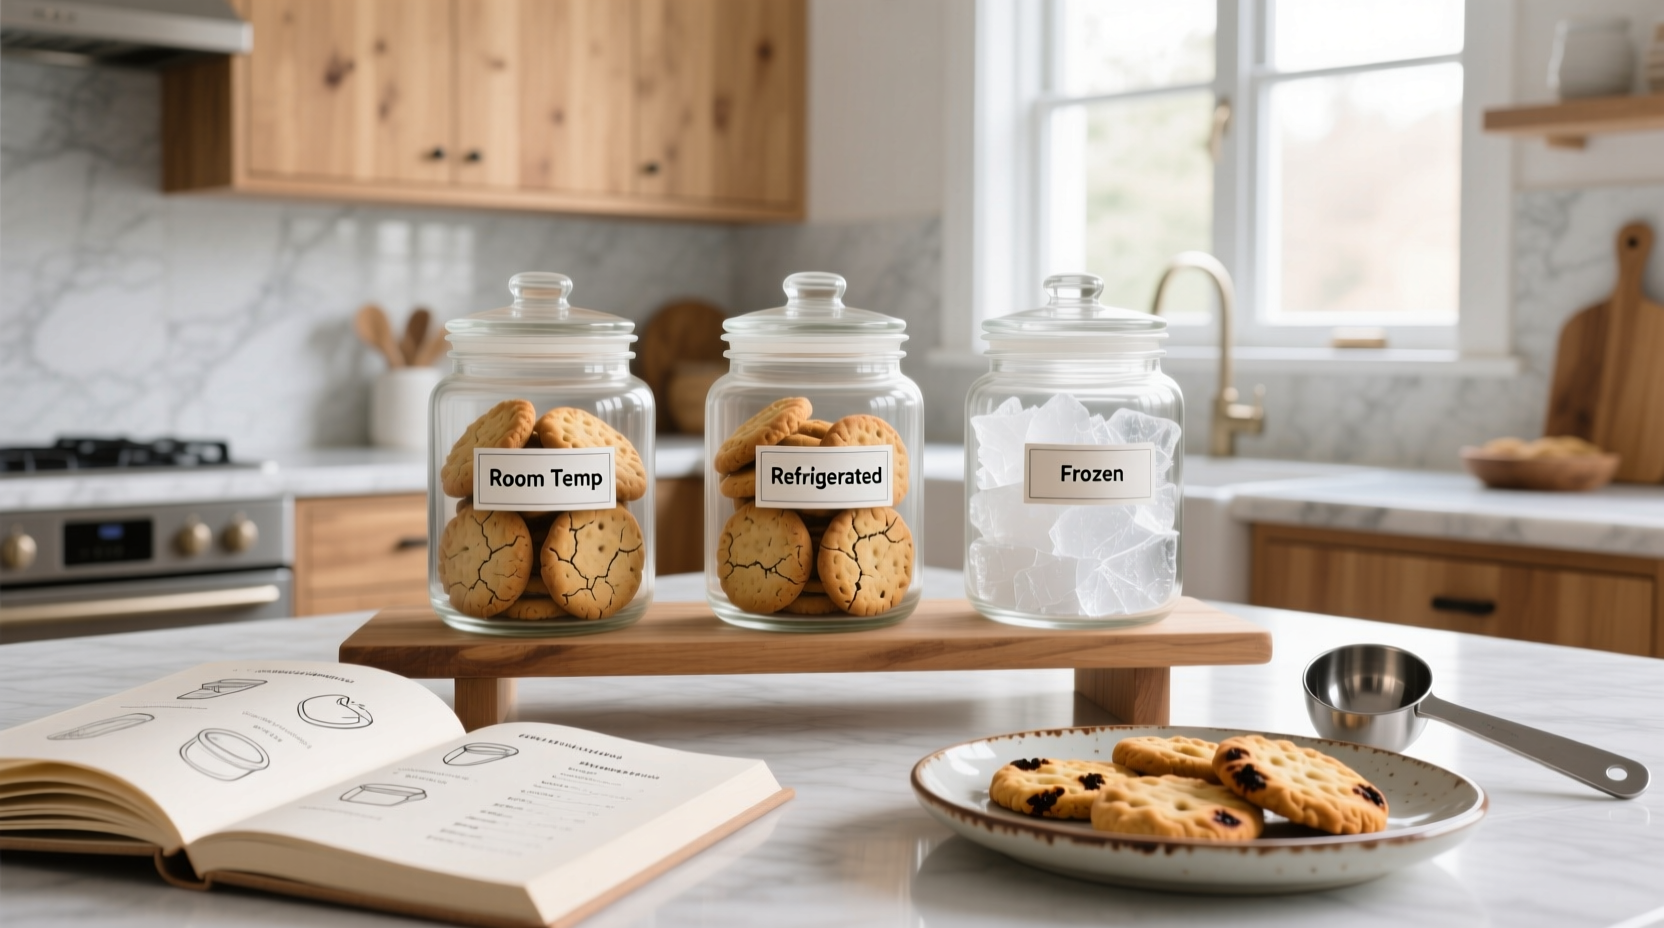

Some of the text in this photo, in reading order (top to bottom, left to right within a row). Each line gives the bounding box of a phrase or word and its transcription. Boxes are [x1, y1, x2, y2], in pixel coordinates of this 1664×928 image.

[489, 468, 603, 491] Room Temp
[771, 465, 882, 490] Refrigerated
[1060, 464, 1124, 483] Frozen
